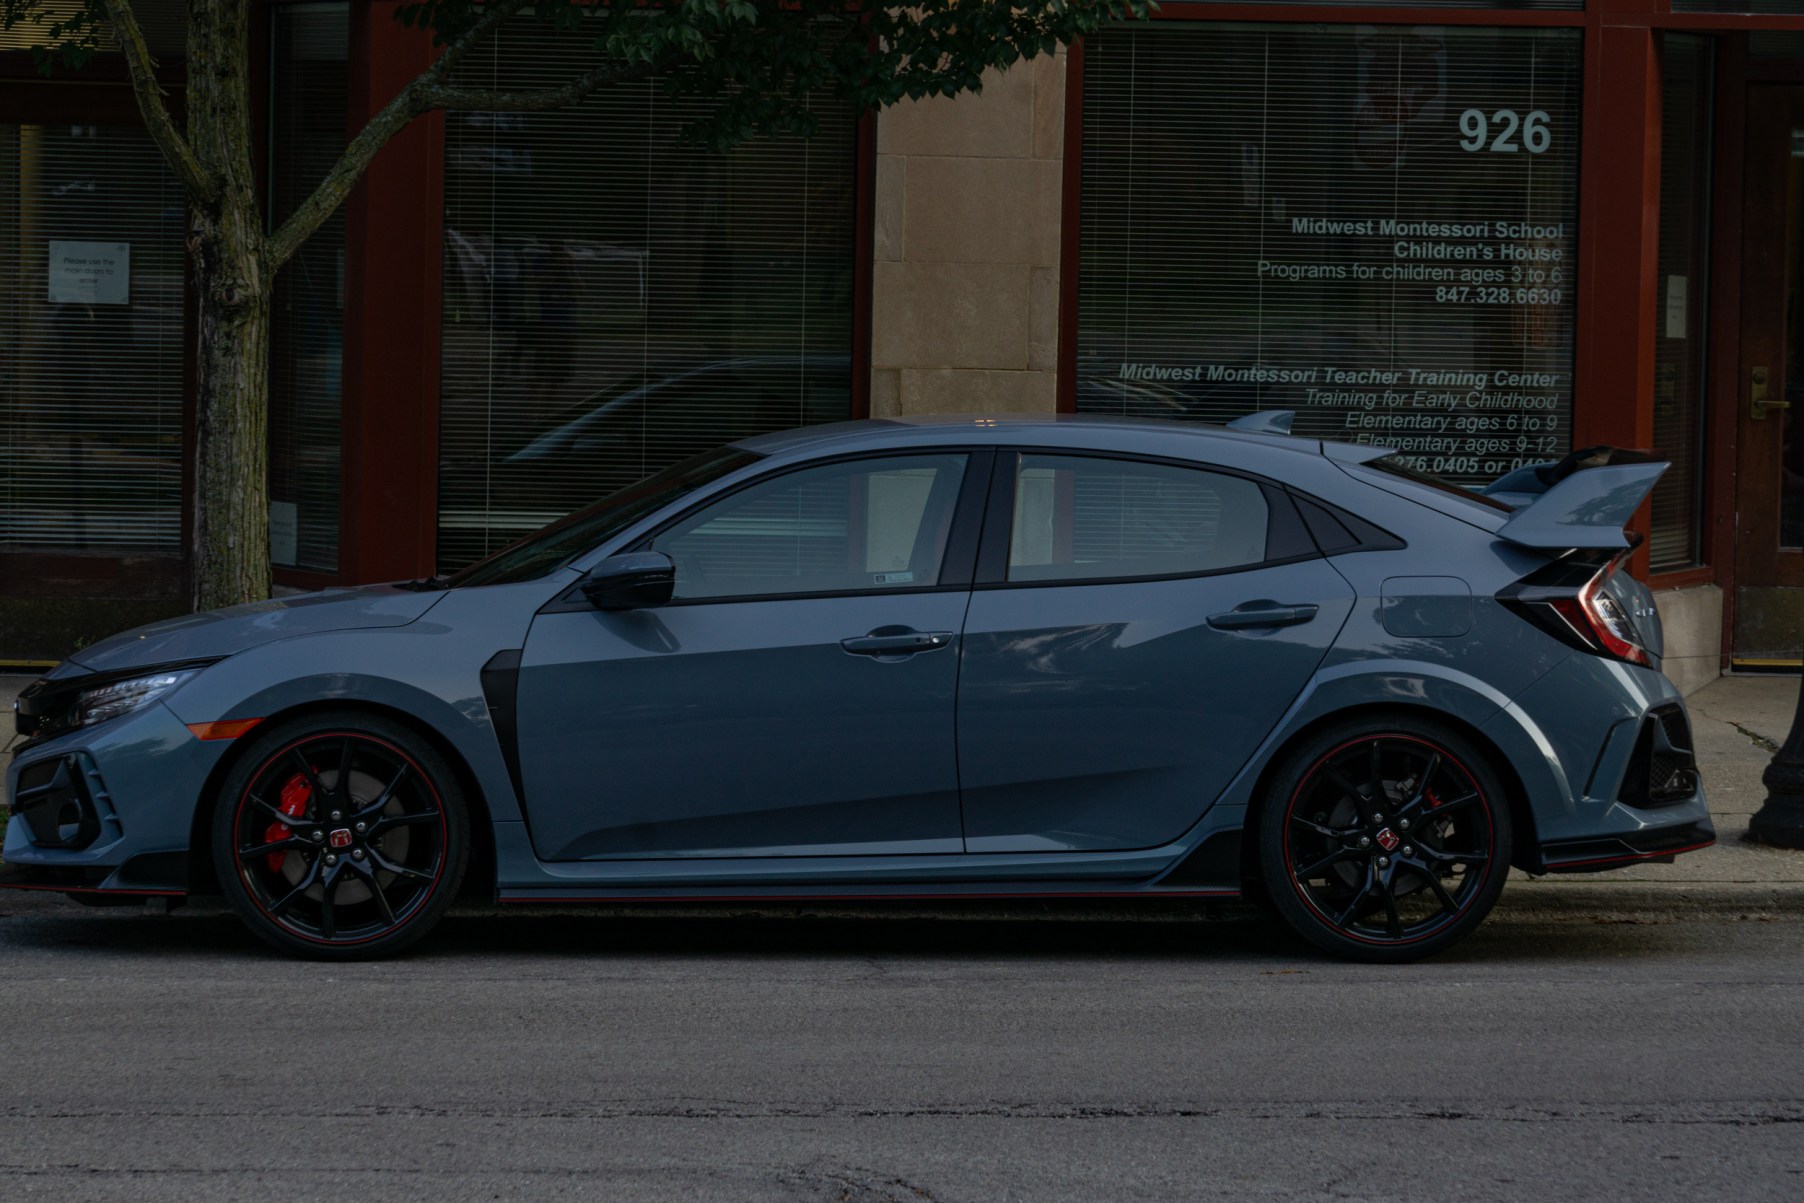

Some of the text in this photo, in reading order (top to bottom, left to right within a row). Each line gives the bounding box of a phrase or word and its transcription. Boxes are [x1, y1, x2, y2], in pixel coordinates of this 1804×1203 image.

[1459, 108, 1551, 154] 926
[1292, 217, 1563, 239] Midwest Montessori School
[1394, 241, 1563, 261] Children's House
[1257, 261, 1562, 285] Programs for children ages 3 to 6
[1435, 286, 1561, 304] 847.328.6630
[1119, 363, 1560, 390] Midwest Montessori Teacher Training Center
[1305, 389, 1559, 411] Training for Early Childhood
[1345, 411, 1558, 434] Elementary ages 6 to 9
[1356, 433, 1558, 456] Elementary ages 9-12
[1484, 461, 1506, 474] or
